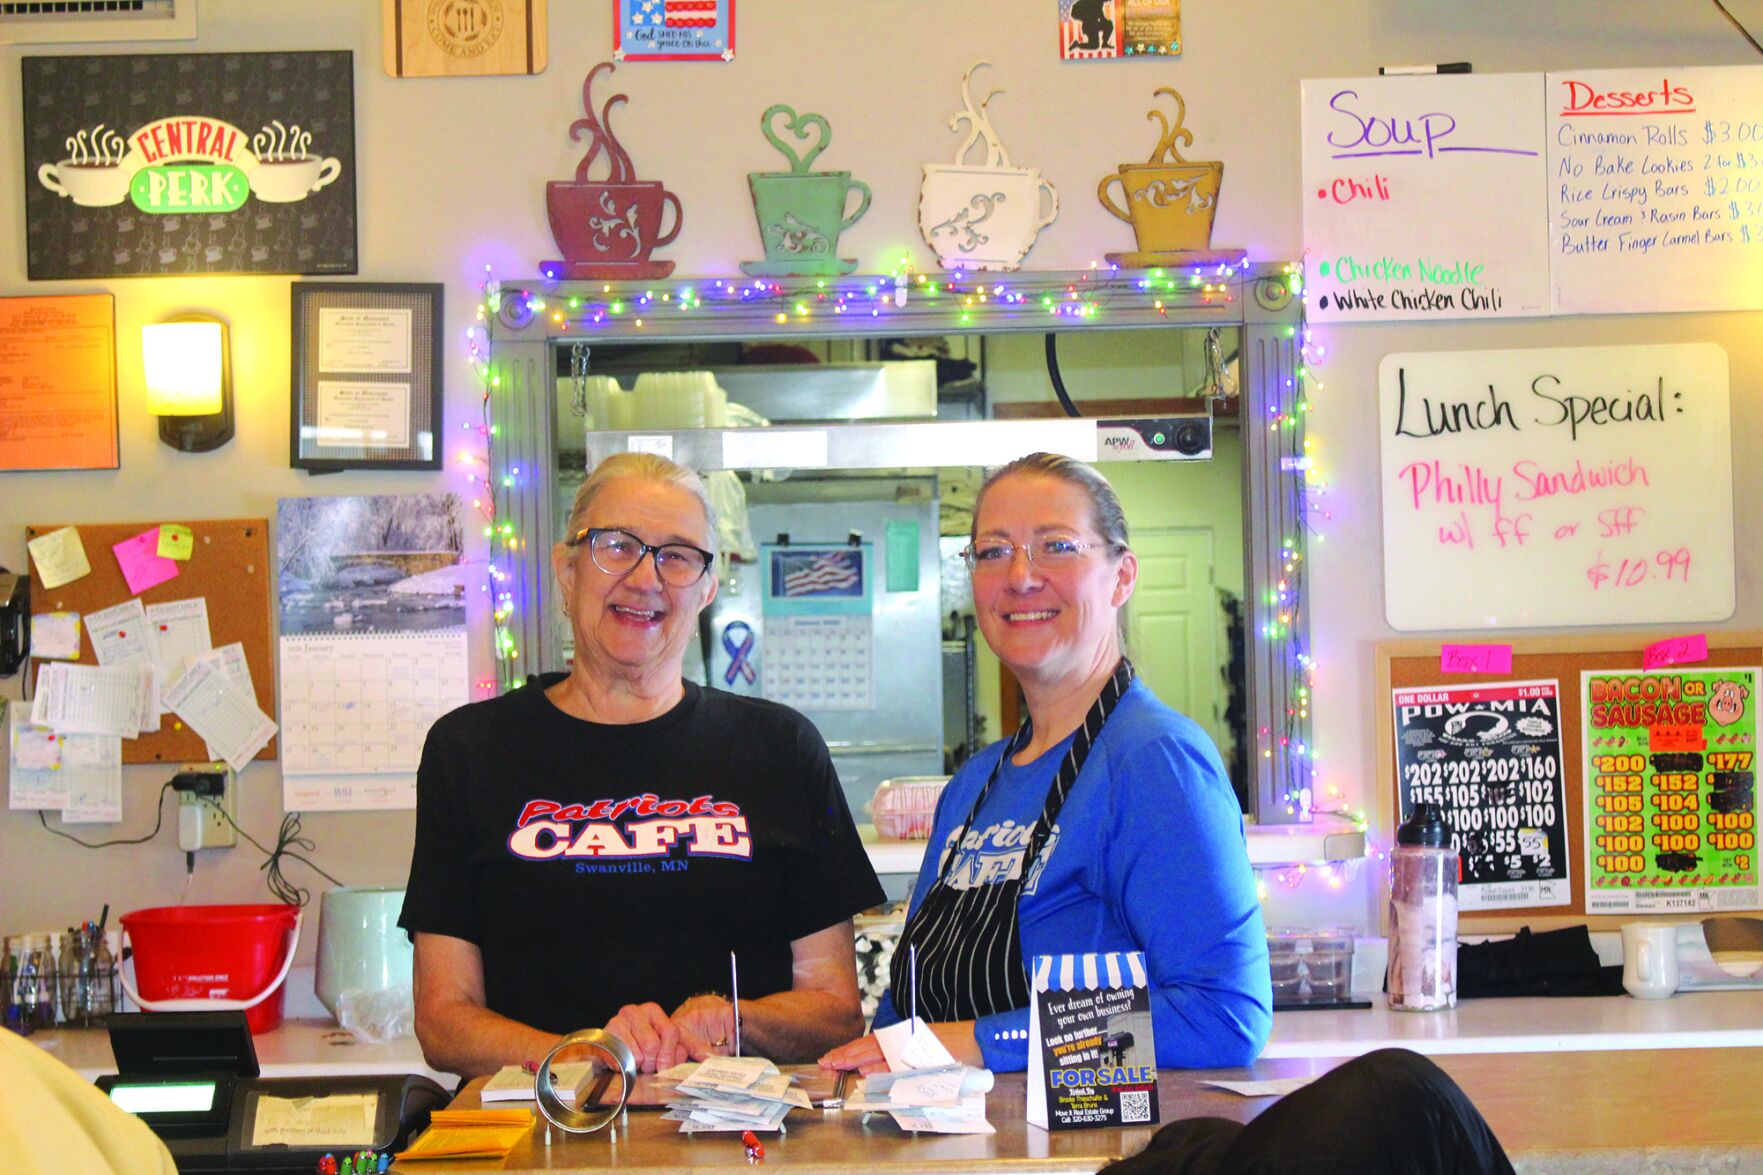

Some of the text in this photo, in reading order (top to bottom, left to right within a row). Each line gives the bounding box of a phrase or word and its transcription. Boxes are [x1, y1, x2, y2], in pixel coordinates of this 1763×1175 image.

[1562, 78, 1694, 111] Desserts
[1327, 90, 1456, 159] Soup
[1558, 123, 1638, 147] Cinnamon
[1642, 123, 1688, 146] Rolls
[137, 121, 237, 163] CENTRAL
[1558, 155, 1583, 178] No
[1594, 155, 1635, 175] Bake
[1703, 153, 1712, 170] 2
[1717, 154, 1733, 168] for
[147, 169, 235, 207] PERK
[1332, 174, 1390, 205] Chili
[1560, 184, 1593, 204] Rice
[1655, 179, 1689, 197] Bars
[1560, 210, 1590, 229] Sour
[1650, 208, 1686, 223] Rasin
[1692, 205, 1721, 222] Bars
[1561, 233, 1609, 255] Butter
[1618, 232, 1657, 256] Finger
[1705, 230, 1733, 244] Bars
[1335, 256, 1485, 285] Chicken Noodle
[1333, 287, 1502, 311] White Chicken Chili
[1396, 368, 1683, 441] Lunch Special:
[1104, 437, 1129, 446] APW
[1398, 456, 1650, 522] Philly Sandwich
[1555, 522, 1581, 540] or
[1586, 548, 1691, 590] $10.99
[1399, 695, 1415, 705] ONE
[1417, 693, 1449, 704] DOLLAR
[1518, 687, 1541, 697] $1.00
[1590, 676, 1682, 703] BACON
[1683, 680, 1706, 696] OR
[1402, 698, 1551, 726] POW MIA
[1591, 701, 1707, 730] SAUSAGE
[1405, 755, 1556, 786] $202 $202 $202 $160
[1592, 752, 1753, 773] $200 $177
[1446, 784, 1480, 808] $105
[1519, 780, 1554, 804] $102
[1595, 773, 1699, 793] $152 $152
[517, 793, 740, 828] Patriots
[1595, 793, 1699, 813] $105 $104
[1448, 804, 1555, 831] $100 $100 $100
[1596, 812, 1754, 833] $102 $100 $100
[507, 815, 753, 862] CAFE
[1490, 830, 1516, 853] $55
[1521, 837, 1543, 850] 55
[1596, 832, 1755, 853] $100 $100 $100
[575, 860, 689, 874] Swanville, MN
[1504, 855, 1522, 869] $5
[1533, 854, 1551, 868] $2
[1597, 855, 1646, 873] $100
[1734, 854, 1750, 870] $2
[1048, 988, 1135, 1016] Ever dream of owning
[1057, 1000, 1132, 1030] your own business?
[1046, 1034, 1063, 1047] Look
[1063, 1032, 1073, 1042] no
[1053, 1035, 1102, 1057] you're already
[1059, 1053, 1083, 1066] sitting
[1082, 1051, 1091, 1061] in
[1050, 1065, 1154, 1088] FOR SALE
[1099, 1107, 1114, 1116] Group
